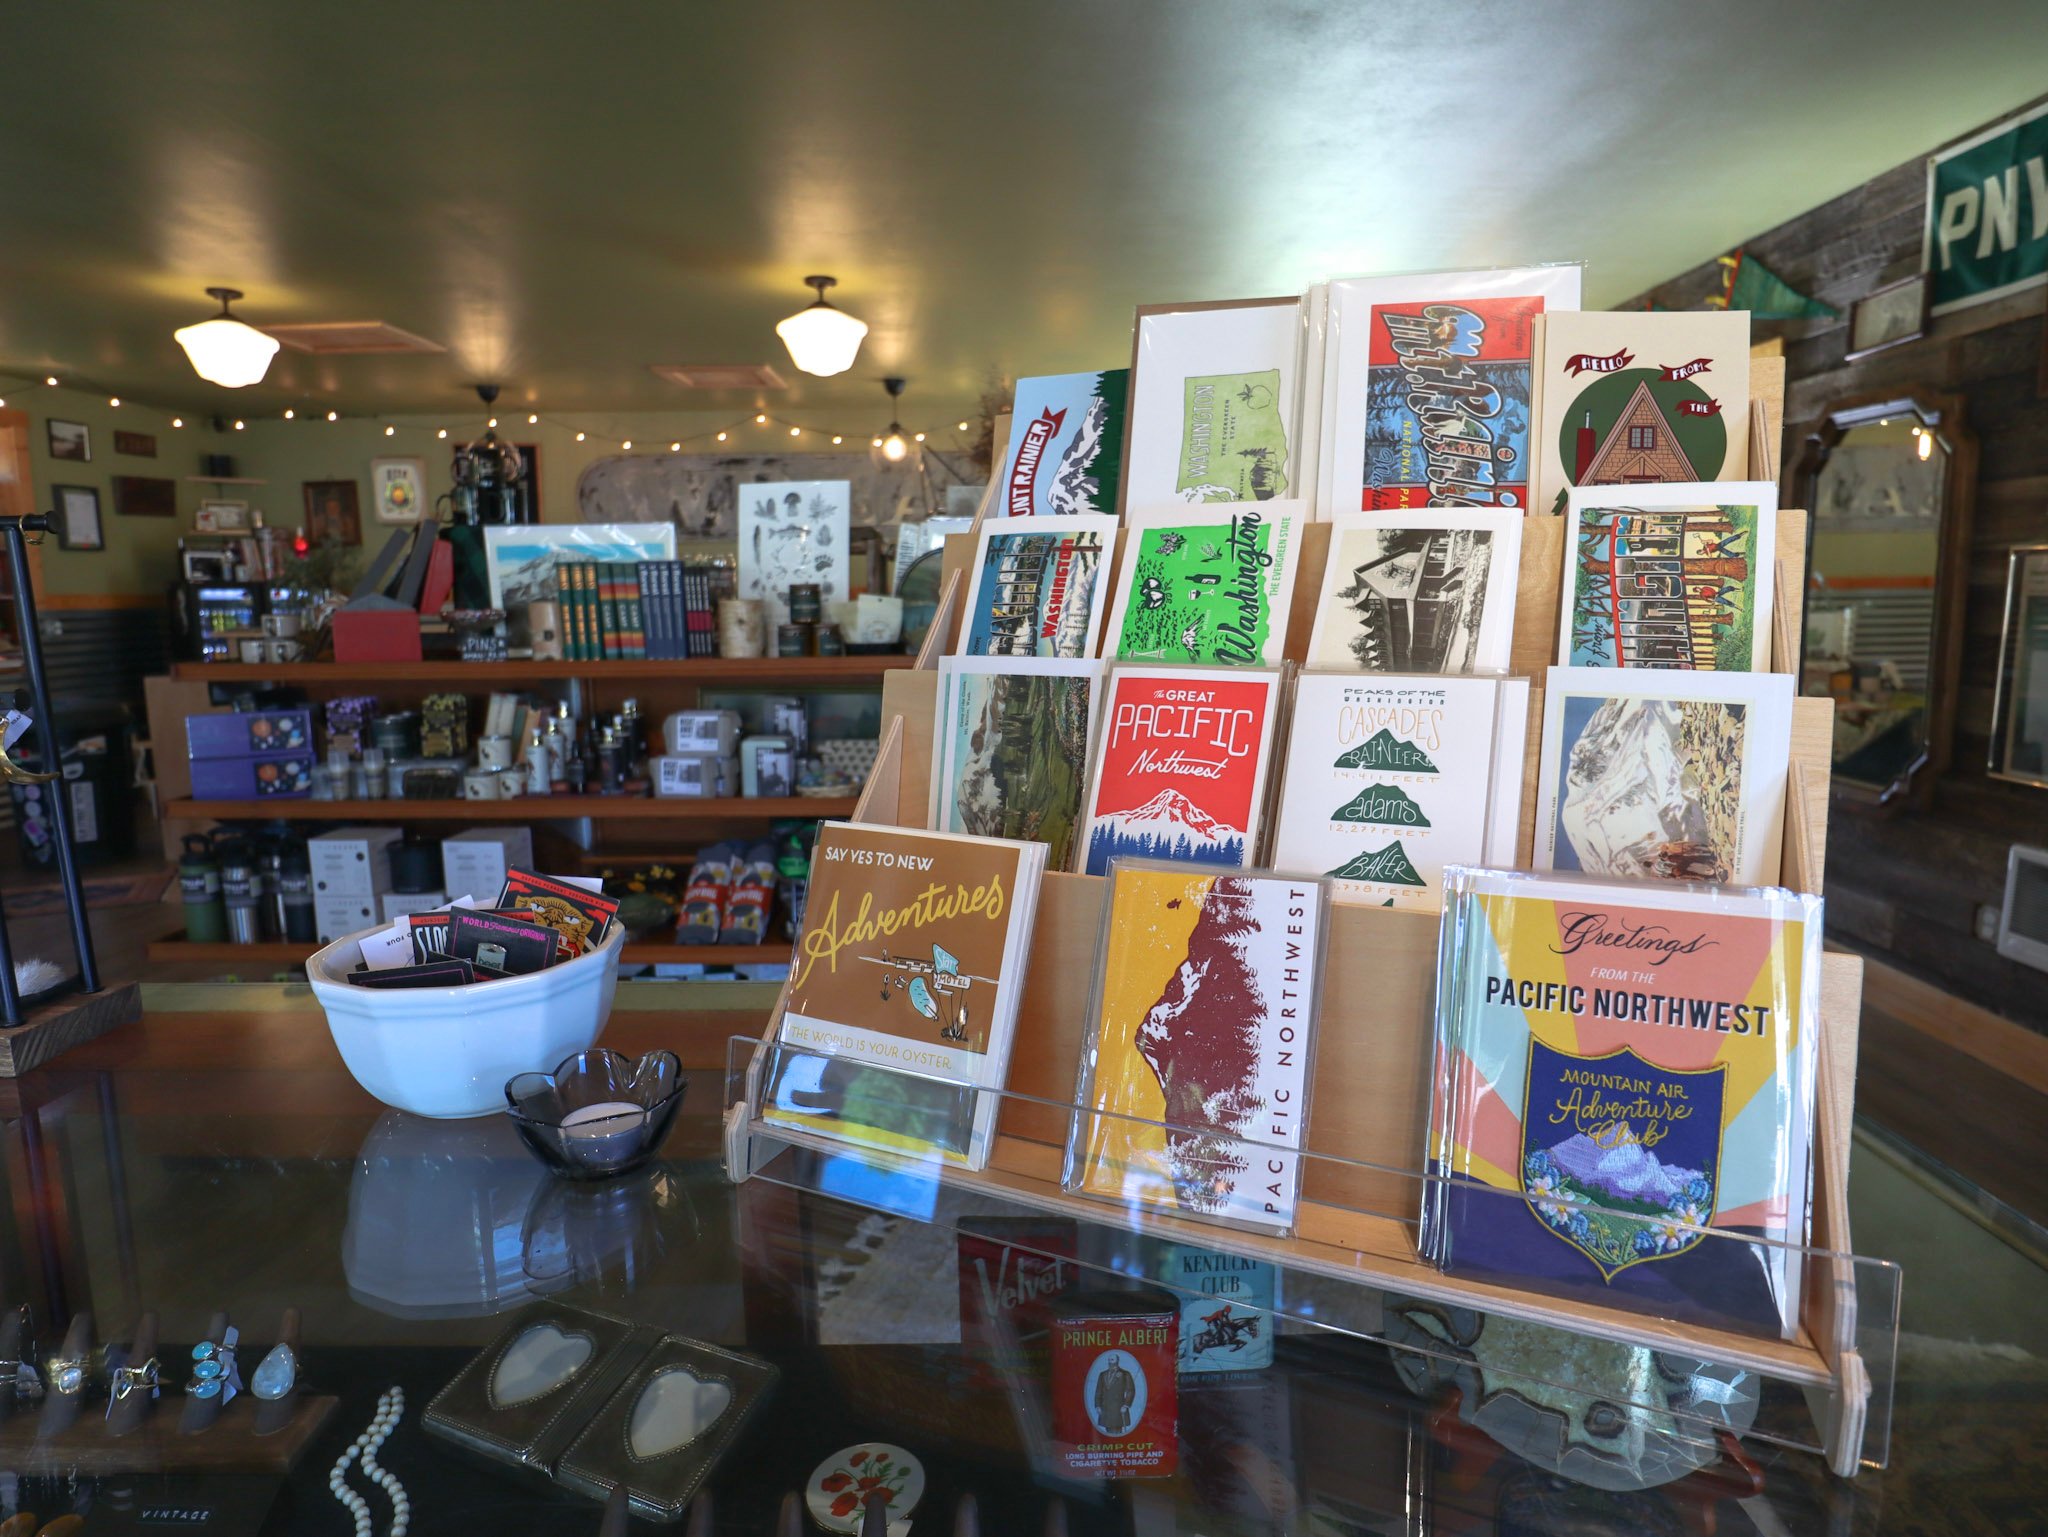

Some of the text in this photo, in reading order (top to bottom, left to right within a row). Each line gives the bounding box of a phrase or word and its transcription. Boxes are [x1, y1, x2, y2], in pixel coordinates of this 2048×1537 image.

[1581, 357, 1623, 372] HELLO
[1672, 362, 1703, 381] FROM
[1221, 399, 1231, 442] EVERGREEN
[1690, 403, 1708, 413] THE
[1187, 384, 1216, 478] WASHINGTON
[1229, 416, 1237, 440] STATE
[1013, 422, 1050, 487] RAINIER
[1400, 421, 1412, 481] NATIONAL
[1406, 378, 1518, 509] Raini
[1269, 516, 1291, 596] THE EVERGREEN STATE
[1215, 512, 1274, 665] Washington
[1584, 619, 1610, 660] from
[1153, 690, 1216, 704] The GREAT
[1344, 688, 1394, 696] PEAKS
[1344, 696, 1445, 706] WASHINGTON
[1111, 704, 1254, 757] PACIFIC
[1338, 706, 1444, 751] CASCADES
[1127, 749, 1231, 781] Northwest
[1341, 738, 1434, 767] RAINIER
[1391, 775, 1440, 784] FEET
[1345, 790, 1417, 824] adams
[1381, 829, 1431, 838] FEET
[825, 847, 933, 871] SAY YES TO NEW
[1340, 847, 1416, 882] BAKER
[1377, 888, 1427, 897] FEET
[462, 916, 490, 929] WORLD
[796, 874, 1004, 990] Adventures
[1549, 912, 1719, 966] Greetings
[478, 958, 502, 969] beer
[1590, 967, 1656, 984] FROM THE
[939, 976, 967, 986] MOTEL
[1486, 976, 1770, 1036] PACIFIC NORTHWEST
[792, 1026, 809, 1041] THE
[812, 1030, 852, 1050] WORLD
[856, 1040, 865, 1052] IS
[869, 1042, 898, 1058] YOUR
[1265, 888, 1306, 1214] PACFIC NORTHWEST
[1560, 1068, 1688, 1099] MOUNTAIN AIR
[1549, 1088, 1693, 1132] Adventure
[1587, 1120, 1668, 1149] Club
[975, 1247, 1067, 1317] Velvet
[1202, 1276, 1240, 1294] CLUB
[1063, 1329, 1168, 1349] PRINCE ALBERT
[1077, 1442, 1154, 1452] CRIMP CUT
[141, 1510, 210, 1520] VINTAGE
